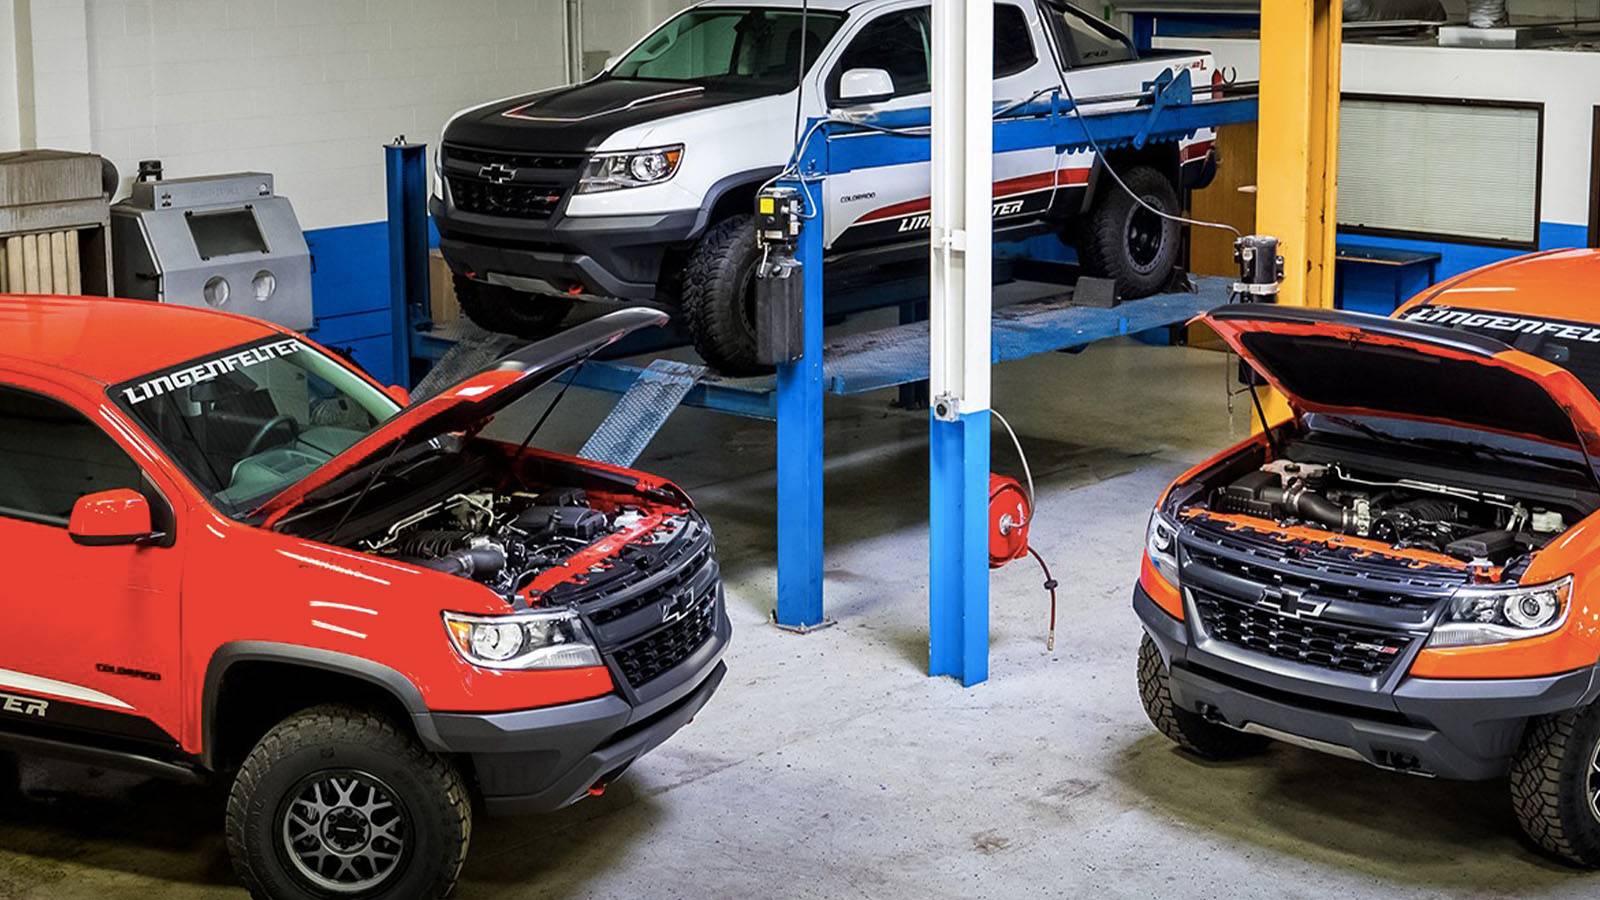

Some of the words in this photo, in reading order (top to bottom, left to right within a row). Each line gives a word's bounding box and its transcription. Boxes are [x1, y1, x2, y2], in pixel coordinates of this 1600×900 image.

[840, 191, 876, 204] COLORADO
[122, 337, 304, 405] LINGENFELTER
[0, 693, 49, 717] ER
